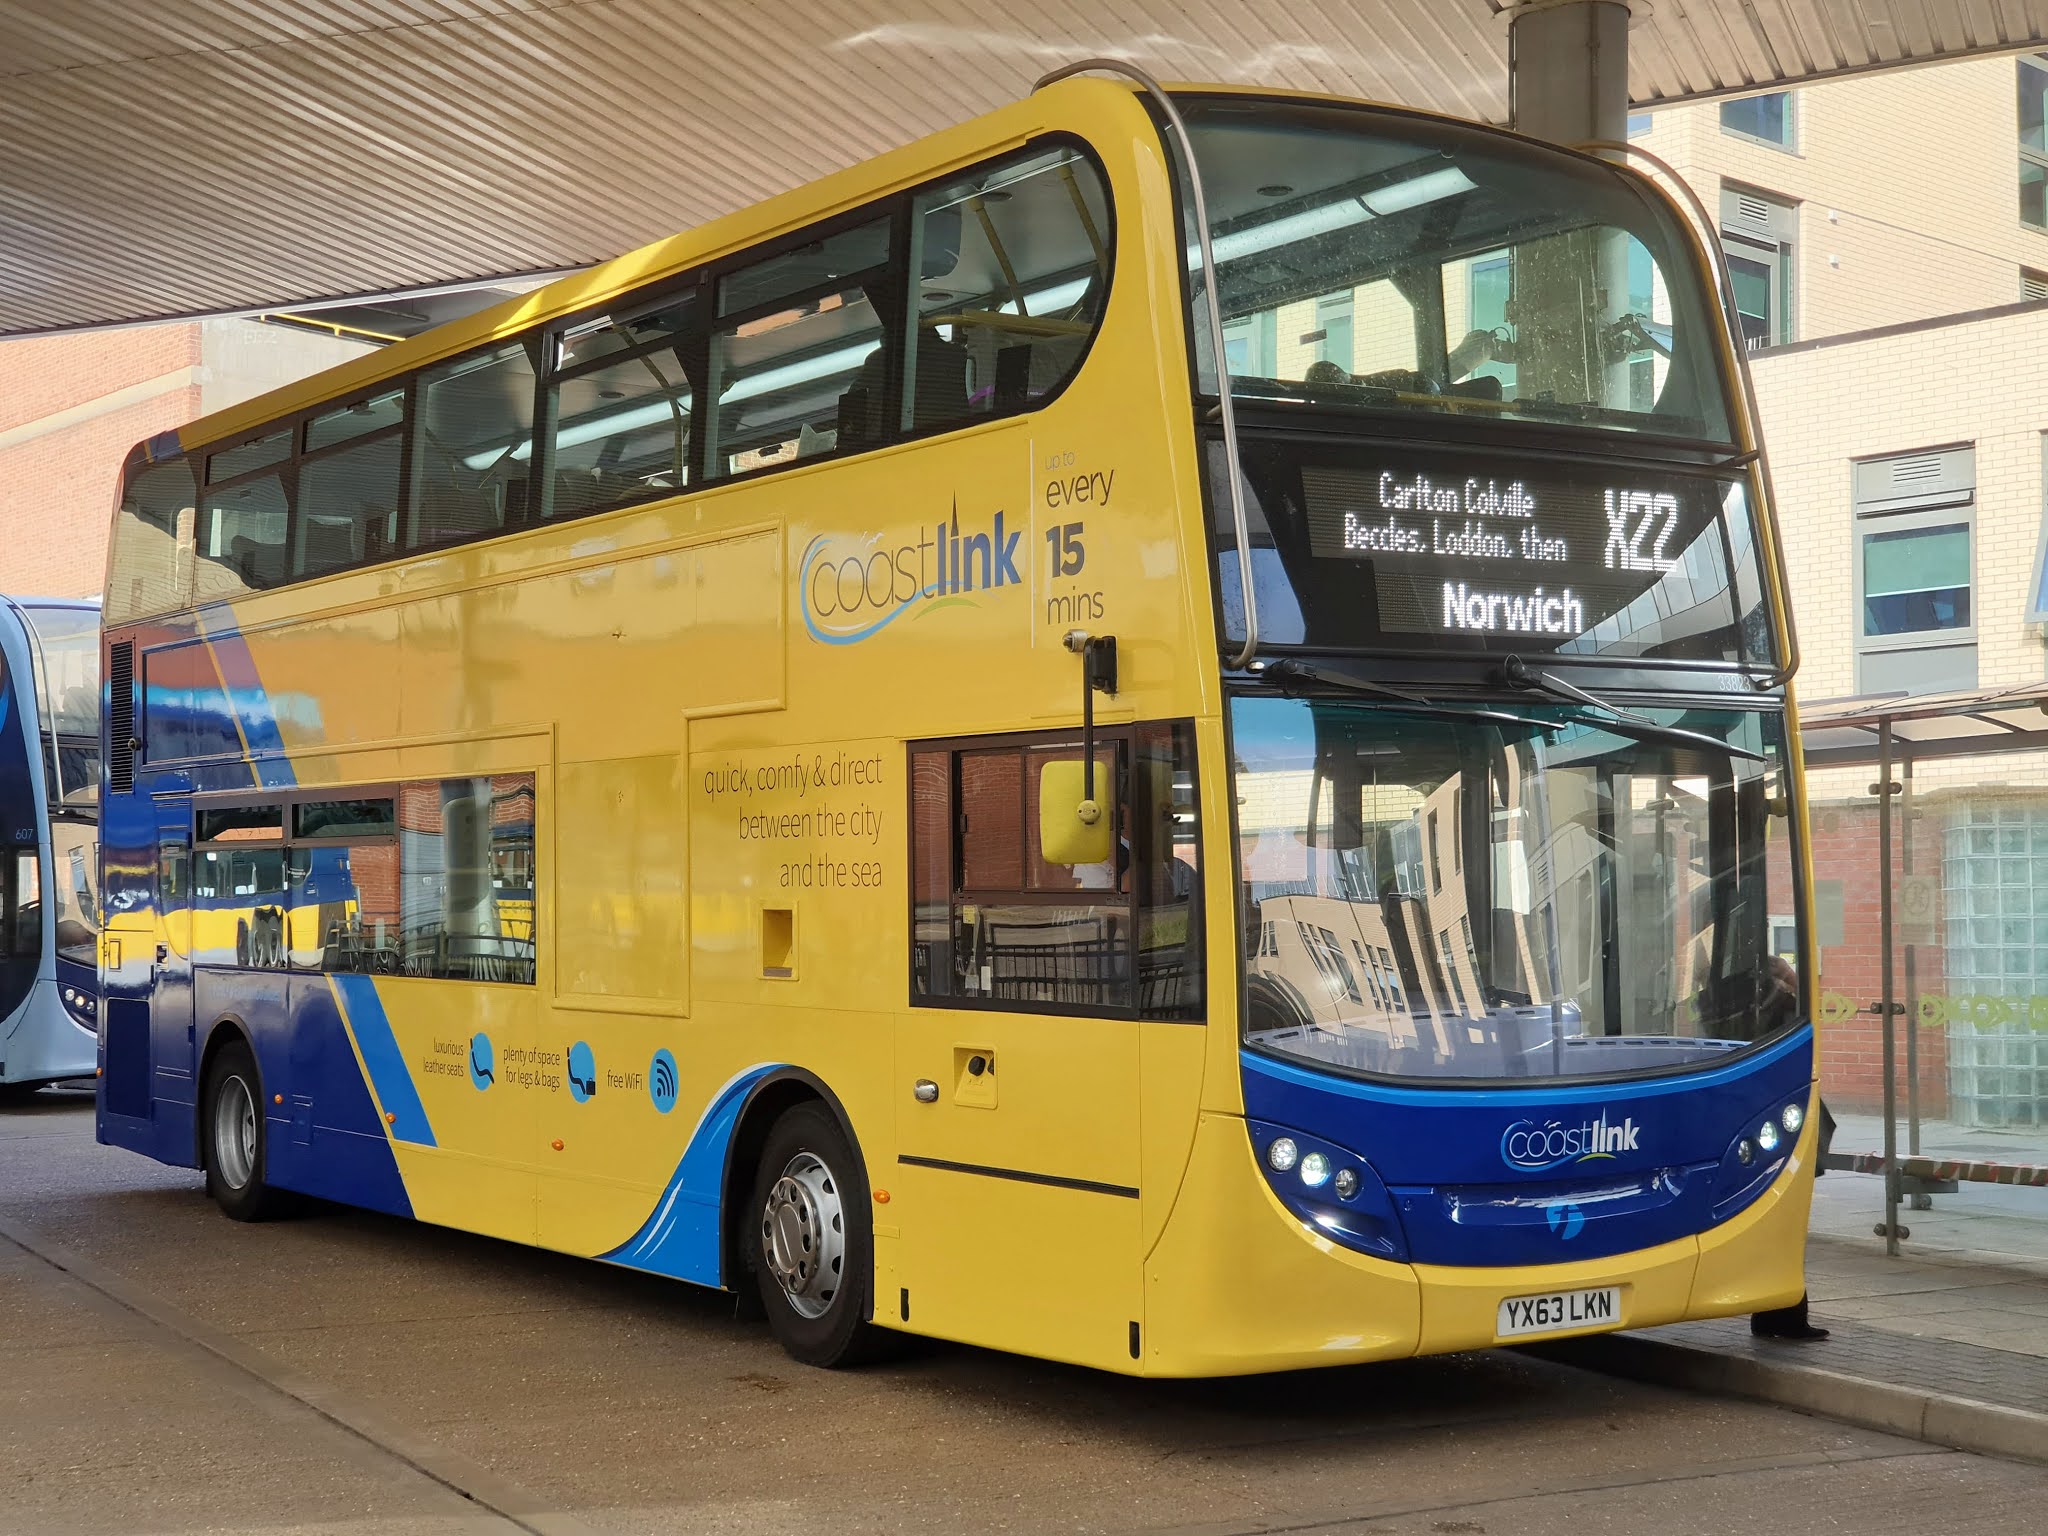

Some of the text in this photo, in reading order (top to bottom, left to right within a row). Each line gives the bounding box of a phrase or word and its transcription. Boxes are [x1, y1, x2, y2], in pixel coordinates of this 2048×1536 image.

[1045, 451, 1075, 472] up to
[1046, 469, 1114, 507] every
[1379, 472, 1534, 517] Carlton Colville
[1520, 525, 1567, 561] then
[1603, 489, 1678, 571] X22
[1046, 522, 1085, 578] 15
[1047, 586, 1104, 625] mins
[1442, 582, 1582, 633] Norwich
[1719, 675, 1751, 691] 33823
[704, 749, 882, 802] quick, comfy & direct
[15, 828, 34, 840] 607
[739, 802, 882, 845] between the city
[780, 852, 882, 887] and the sea
[433, 1038, 464, 1056] luxurious
[503, 1046, 560, 1068] plenty of space
[423, 1056, 464, 1077] leather seats
[505, 1066, 560, 1092] for legs & bags
[607, 1070, 643, 1091] free WiFi
[1509, 1115, 1640, 1159] coastlink
[1507, 1291, 1611, 1328] YX63 LKN
